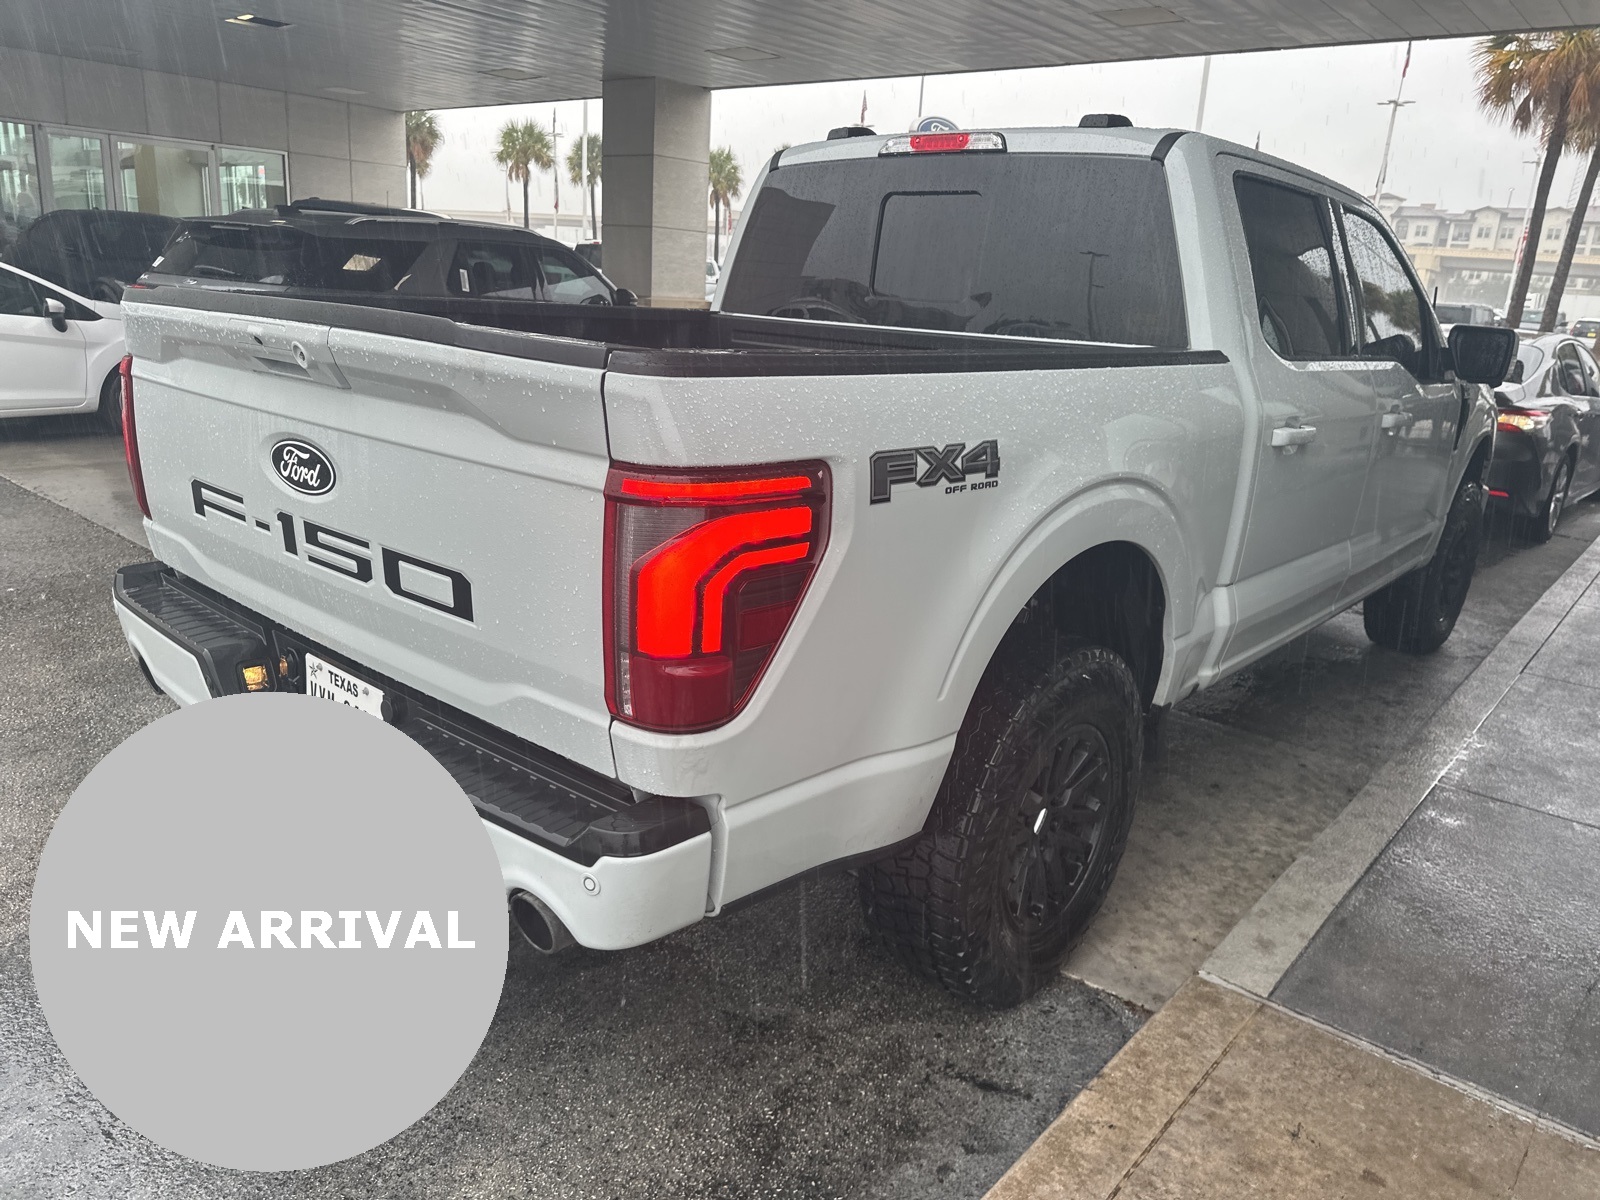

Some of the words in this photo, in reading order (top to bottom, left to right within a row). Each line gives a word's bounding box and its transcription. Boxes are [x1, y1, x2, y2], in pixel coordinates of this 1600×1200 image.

[280, 446, 321, 487] Ford
[869, 439, 1000, 505] FX4
[945, 484, 967, 495] OFF
[970, 480, 999, 491] ROAD
[190, 478, 475, 623] F-150
[327, 669, 359, 698] TEXAS
